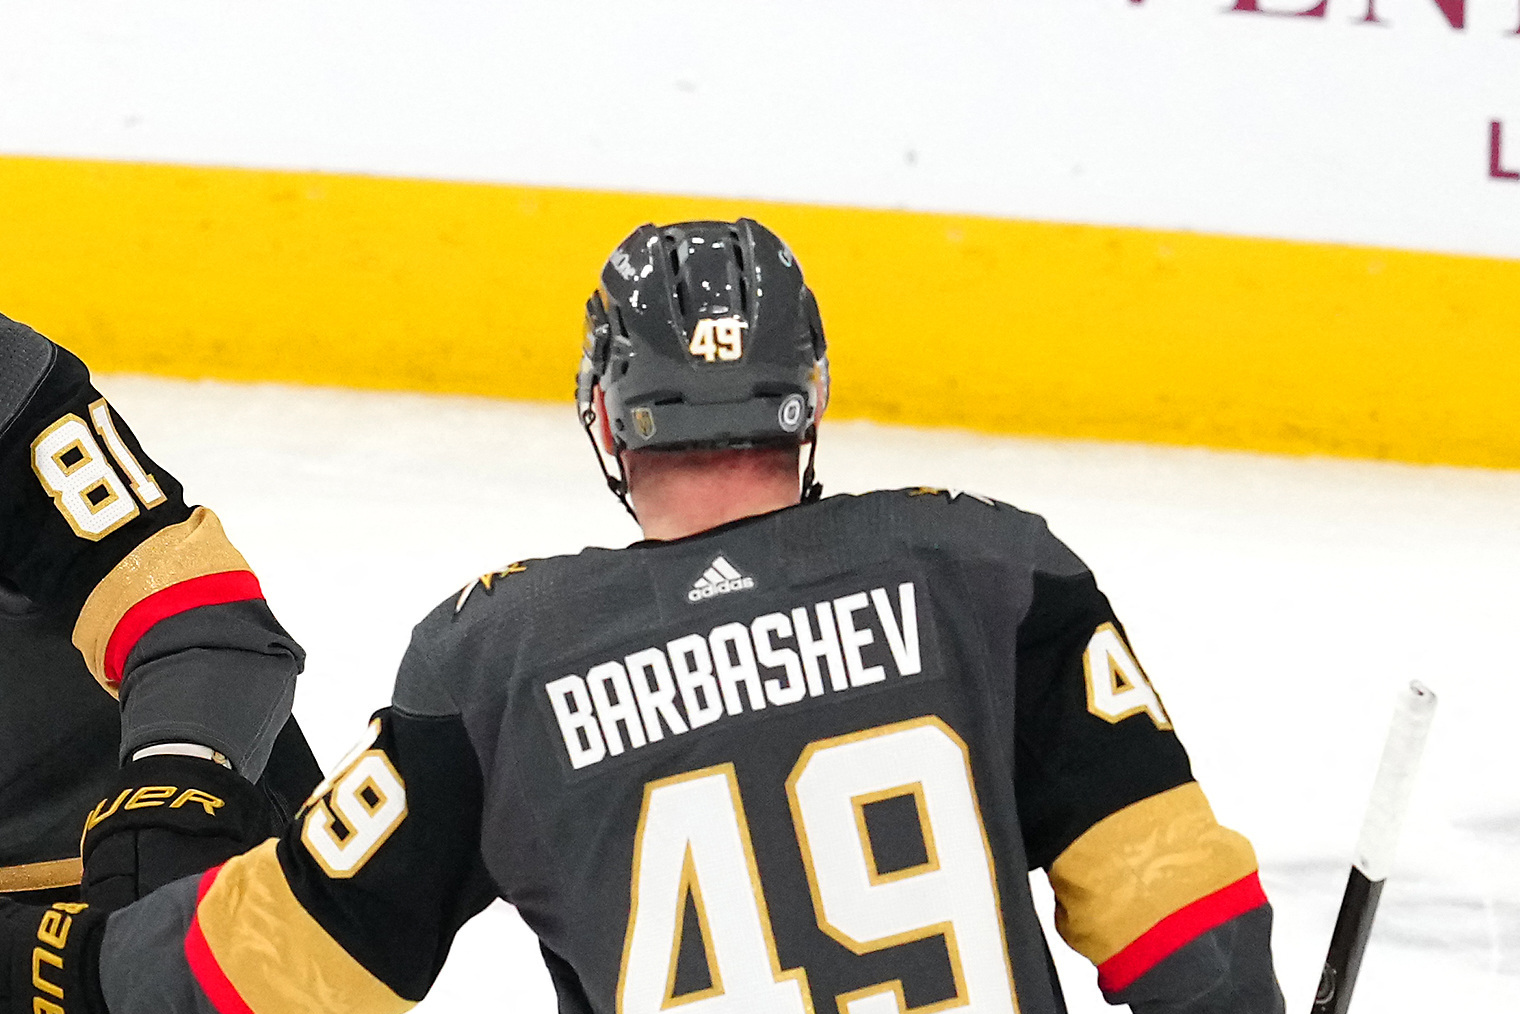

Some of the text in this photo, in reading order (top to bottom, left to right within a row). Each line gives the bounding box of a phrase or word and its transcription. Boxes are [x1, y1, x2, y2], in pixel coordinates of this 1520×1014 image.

[689, 317, 746, 362] 49
[30, 397, 168, 542] 81
[688, 577, 755, 601] adidas
[545, 581, 923, 770] BARBASHEV
[83, 786, 226, 831] UER
[294, 716, 409, 879] 9
